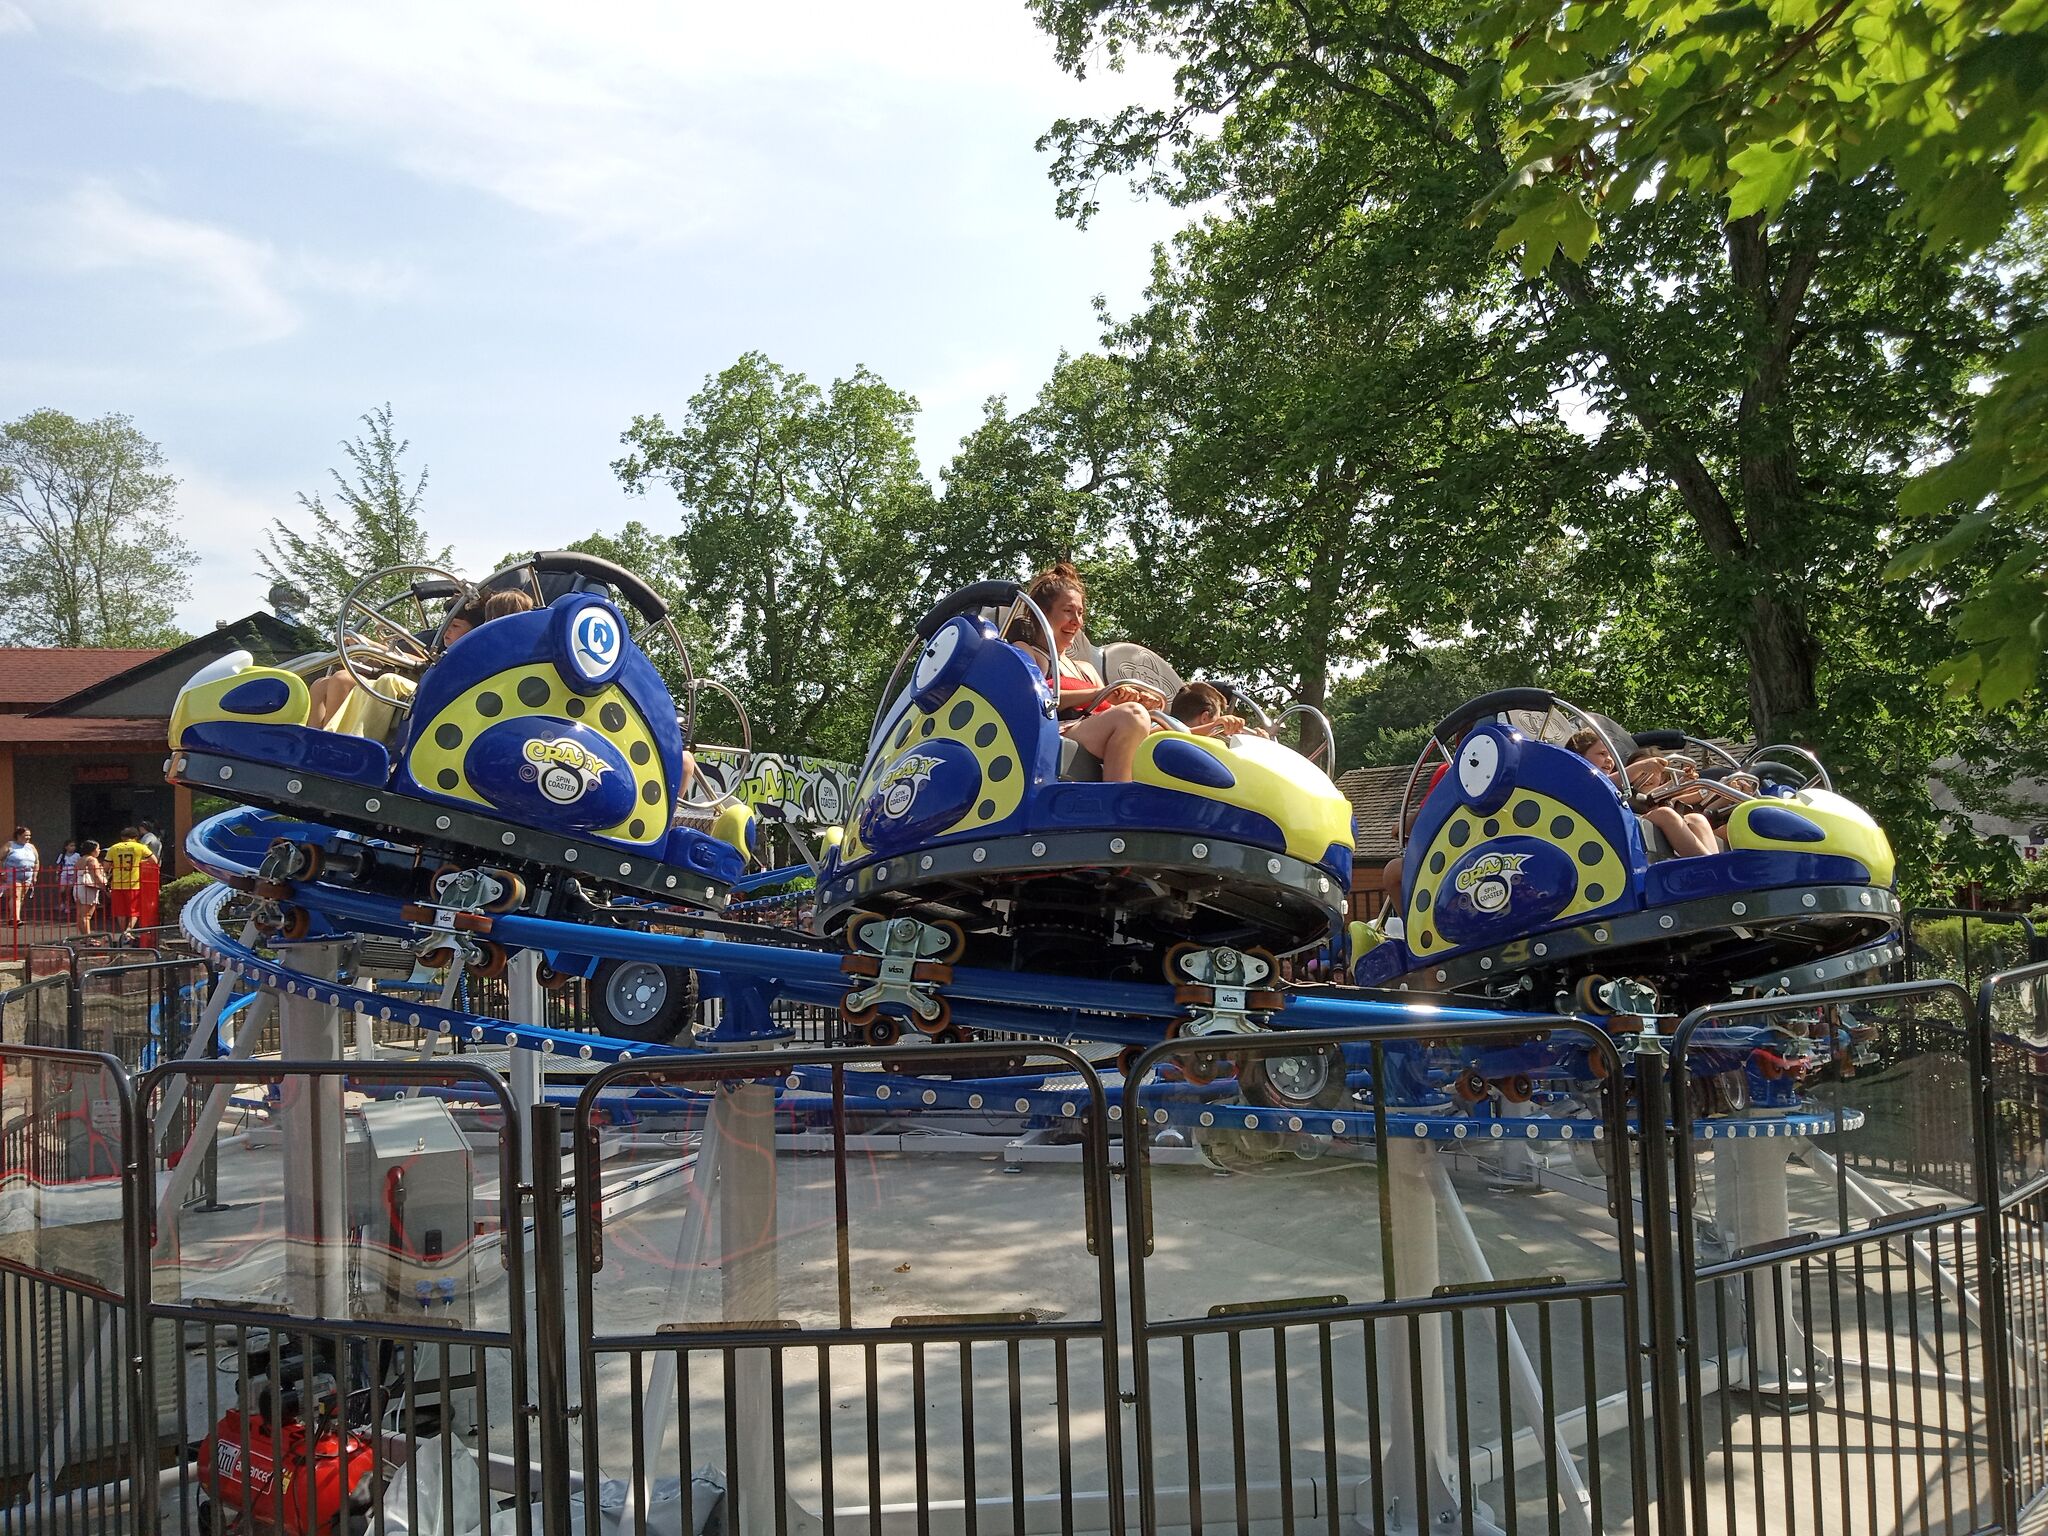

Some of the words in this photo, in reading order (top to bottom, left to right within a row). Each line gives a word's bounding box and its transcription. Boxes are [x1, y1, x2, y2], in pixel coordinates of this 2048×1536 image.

[526, 741, 606, 778] CRAZY
[555, 775, 571, 784] SPIN
[547, 780, 576, 793] COASTER
[823, 786, 834, 797] SPIN
[820, 797, 837, 809] COASTER
[118, 854, 133, 872] 13
[1457, 856, 1524, 890] CRAZY
[1479, 889, 1505, 902] COASTER
[1484, 885, 1498, 895] SPIN
